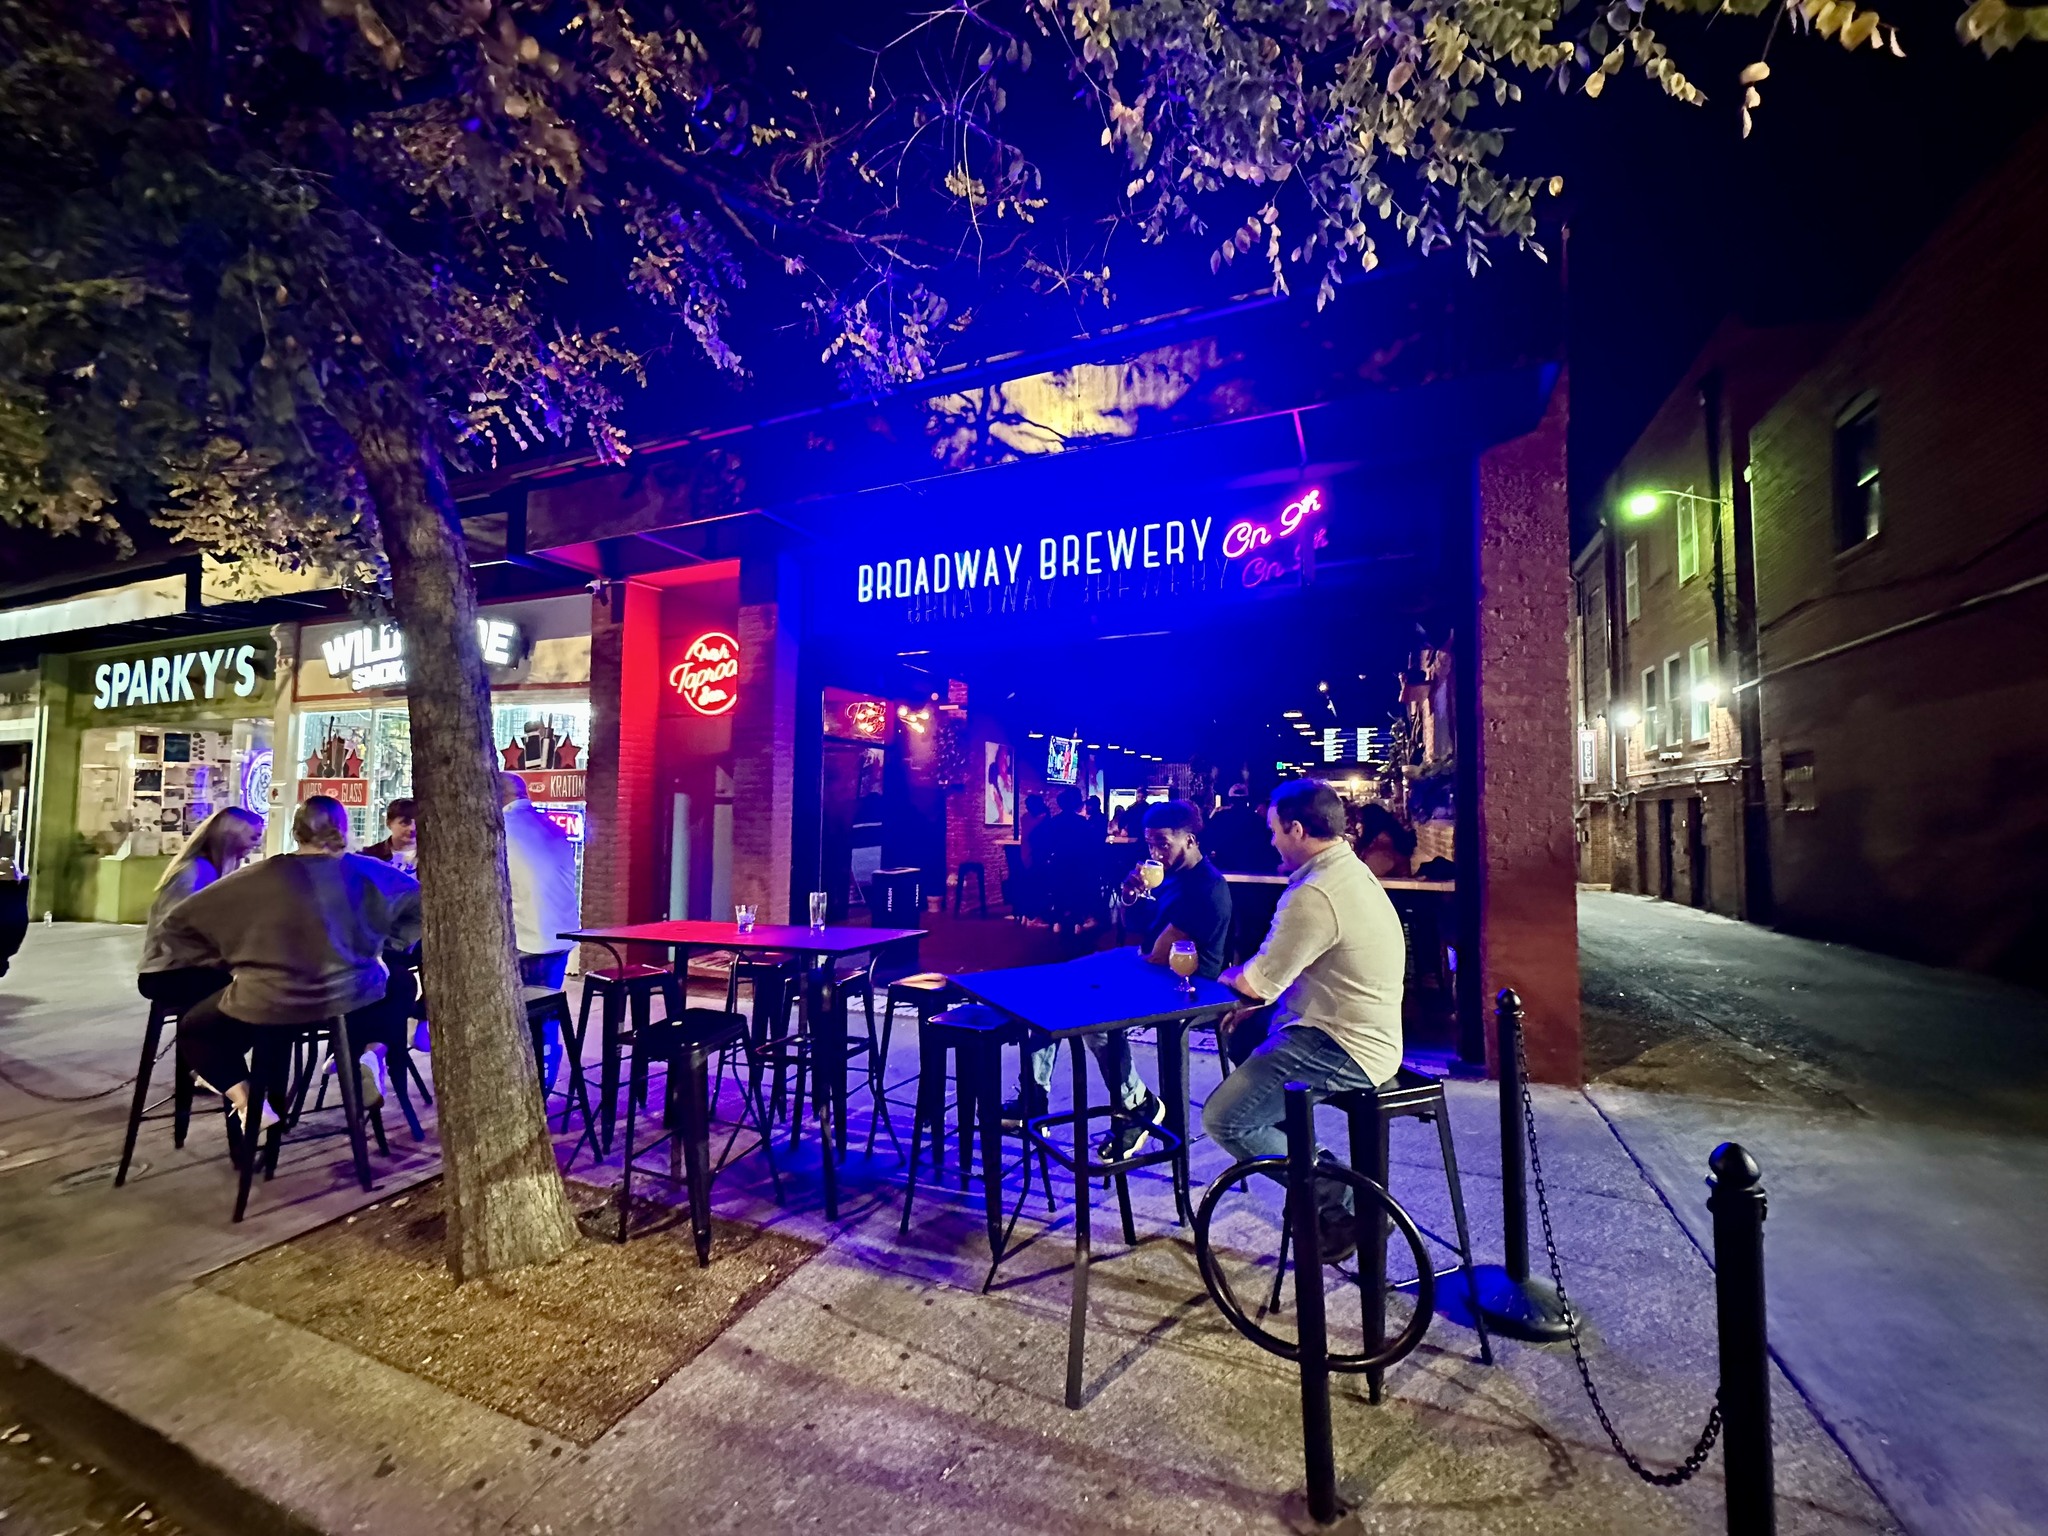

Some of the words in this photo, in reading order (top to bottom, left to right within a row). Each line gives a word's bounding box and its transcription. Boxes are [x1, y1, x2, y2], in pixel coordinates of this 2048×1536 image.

[1222, 521, 1272, 558] On
[858, 543, 1022, 603] BROADWAY
[1039, 516, 1212, 580] BREWERY
[93, 644, 256, 710] SPARKY'S
[351, 659, 407, 692] SMOK
[669, 659, 738, 698] Taproo
[341, 782, 363, 802] GLASS
[550, 774, 586, 798] KRATOM
